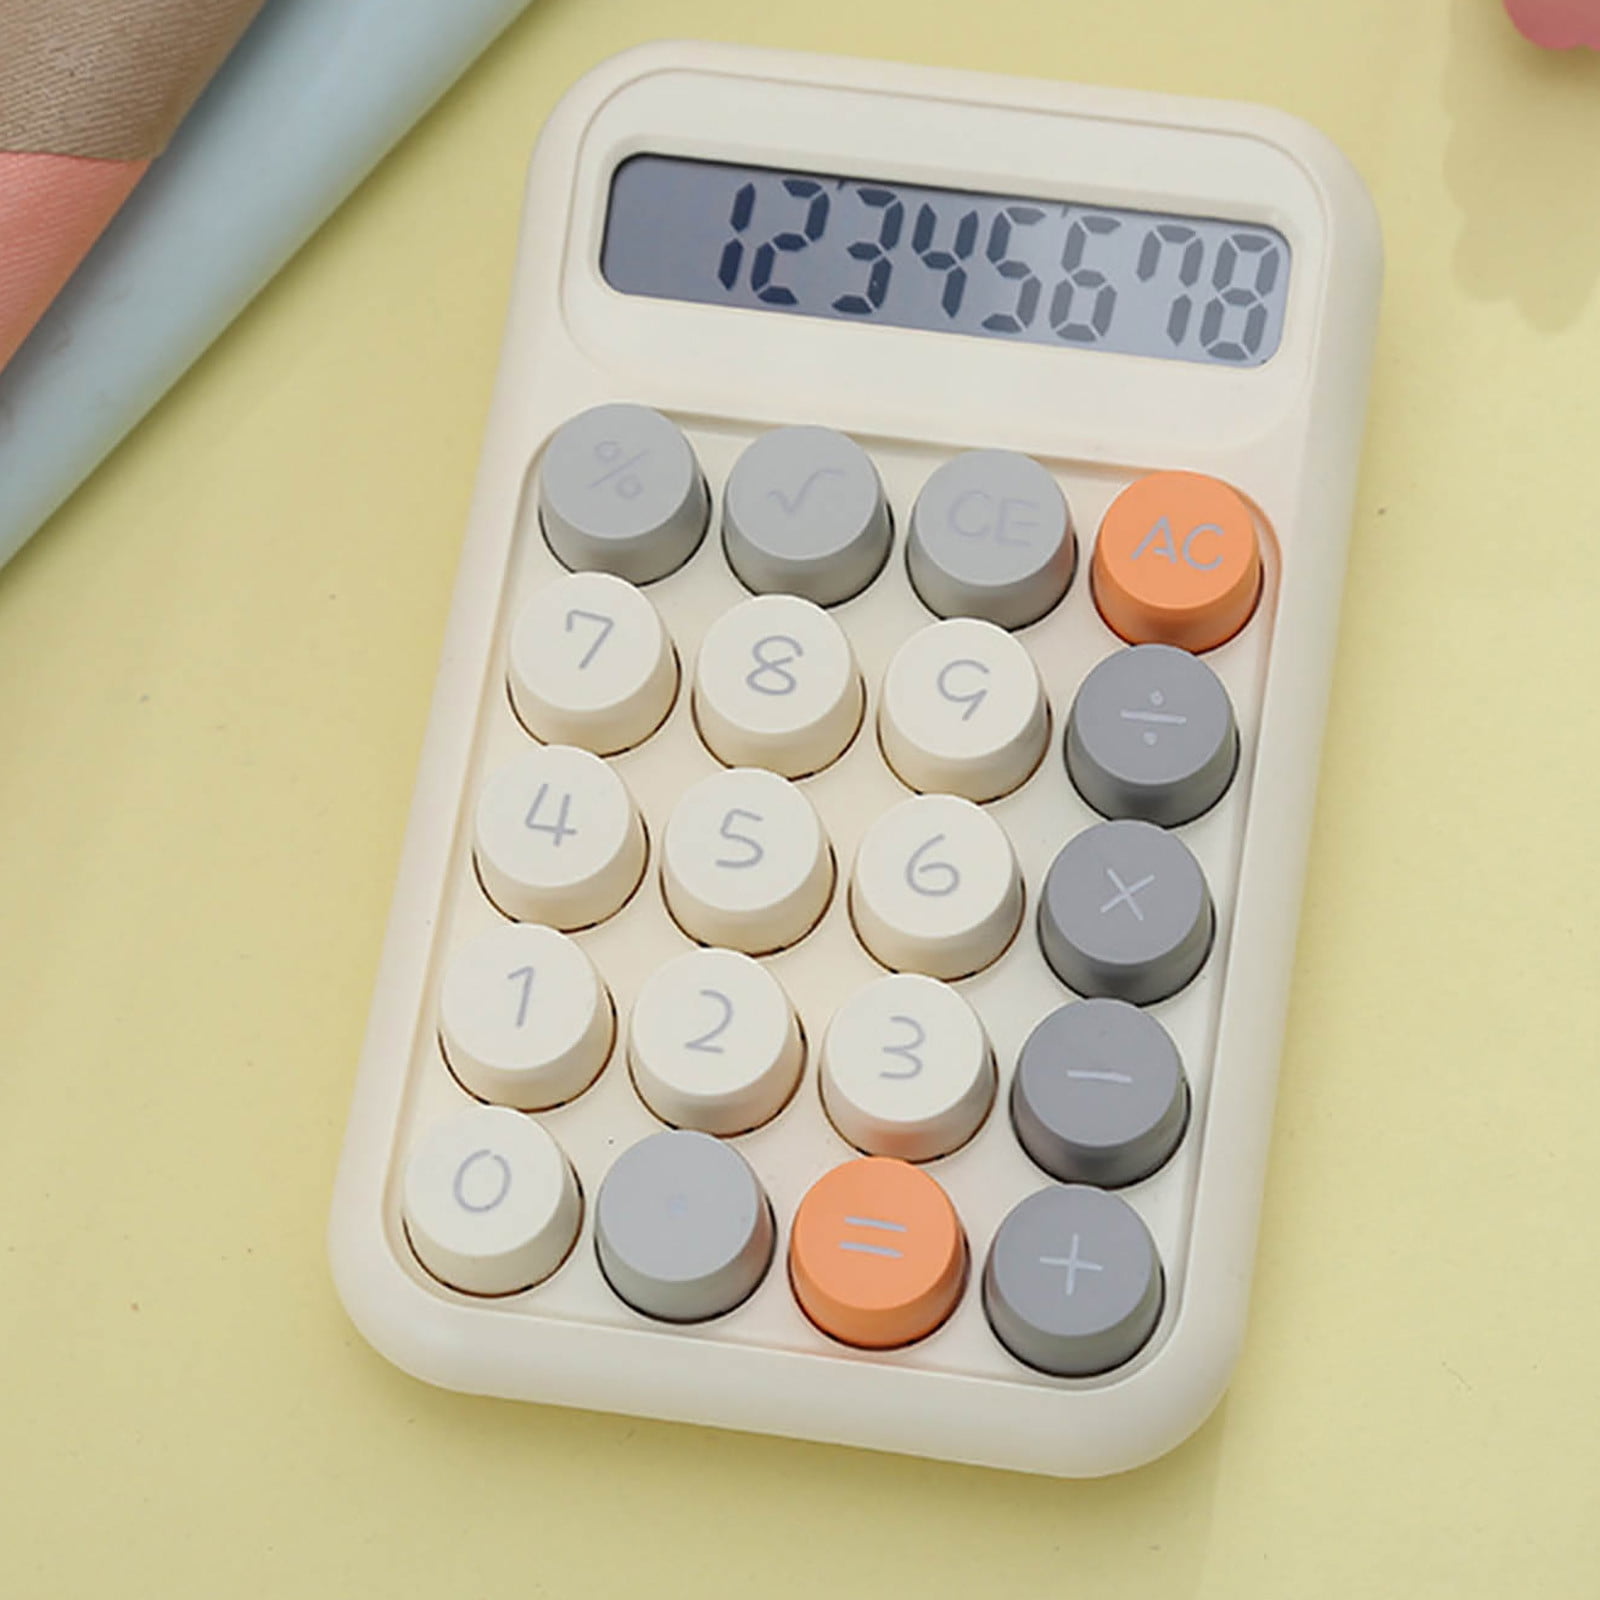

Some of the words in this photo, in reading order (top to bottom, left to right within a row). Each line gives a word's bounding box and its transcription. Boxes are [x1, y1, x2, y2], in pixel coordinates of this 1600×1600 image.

[947, 490, 1041, 549] CE
[1130, 513, 1227, 574] AC
[564, 608, 616, 670] 7
[743, 634, 805, 697] 8
[936, 658, 992, 723] 9
[523, 782, 579, 848] 4
[714, 808, 766, 869] 5
[905, 833, 962, 898] 6
[505, 964, 537, 1029] 1
[683, 988, 735, 1055] 2
[878, 1015, 928, 1080] 3
[451, 1148, 513, 1214] 0
